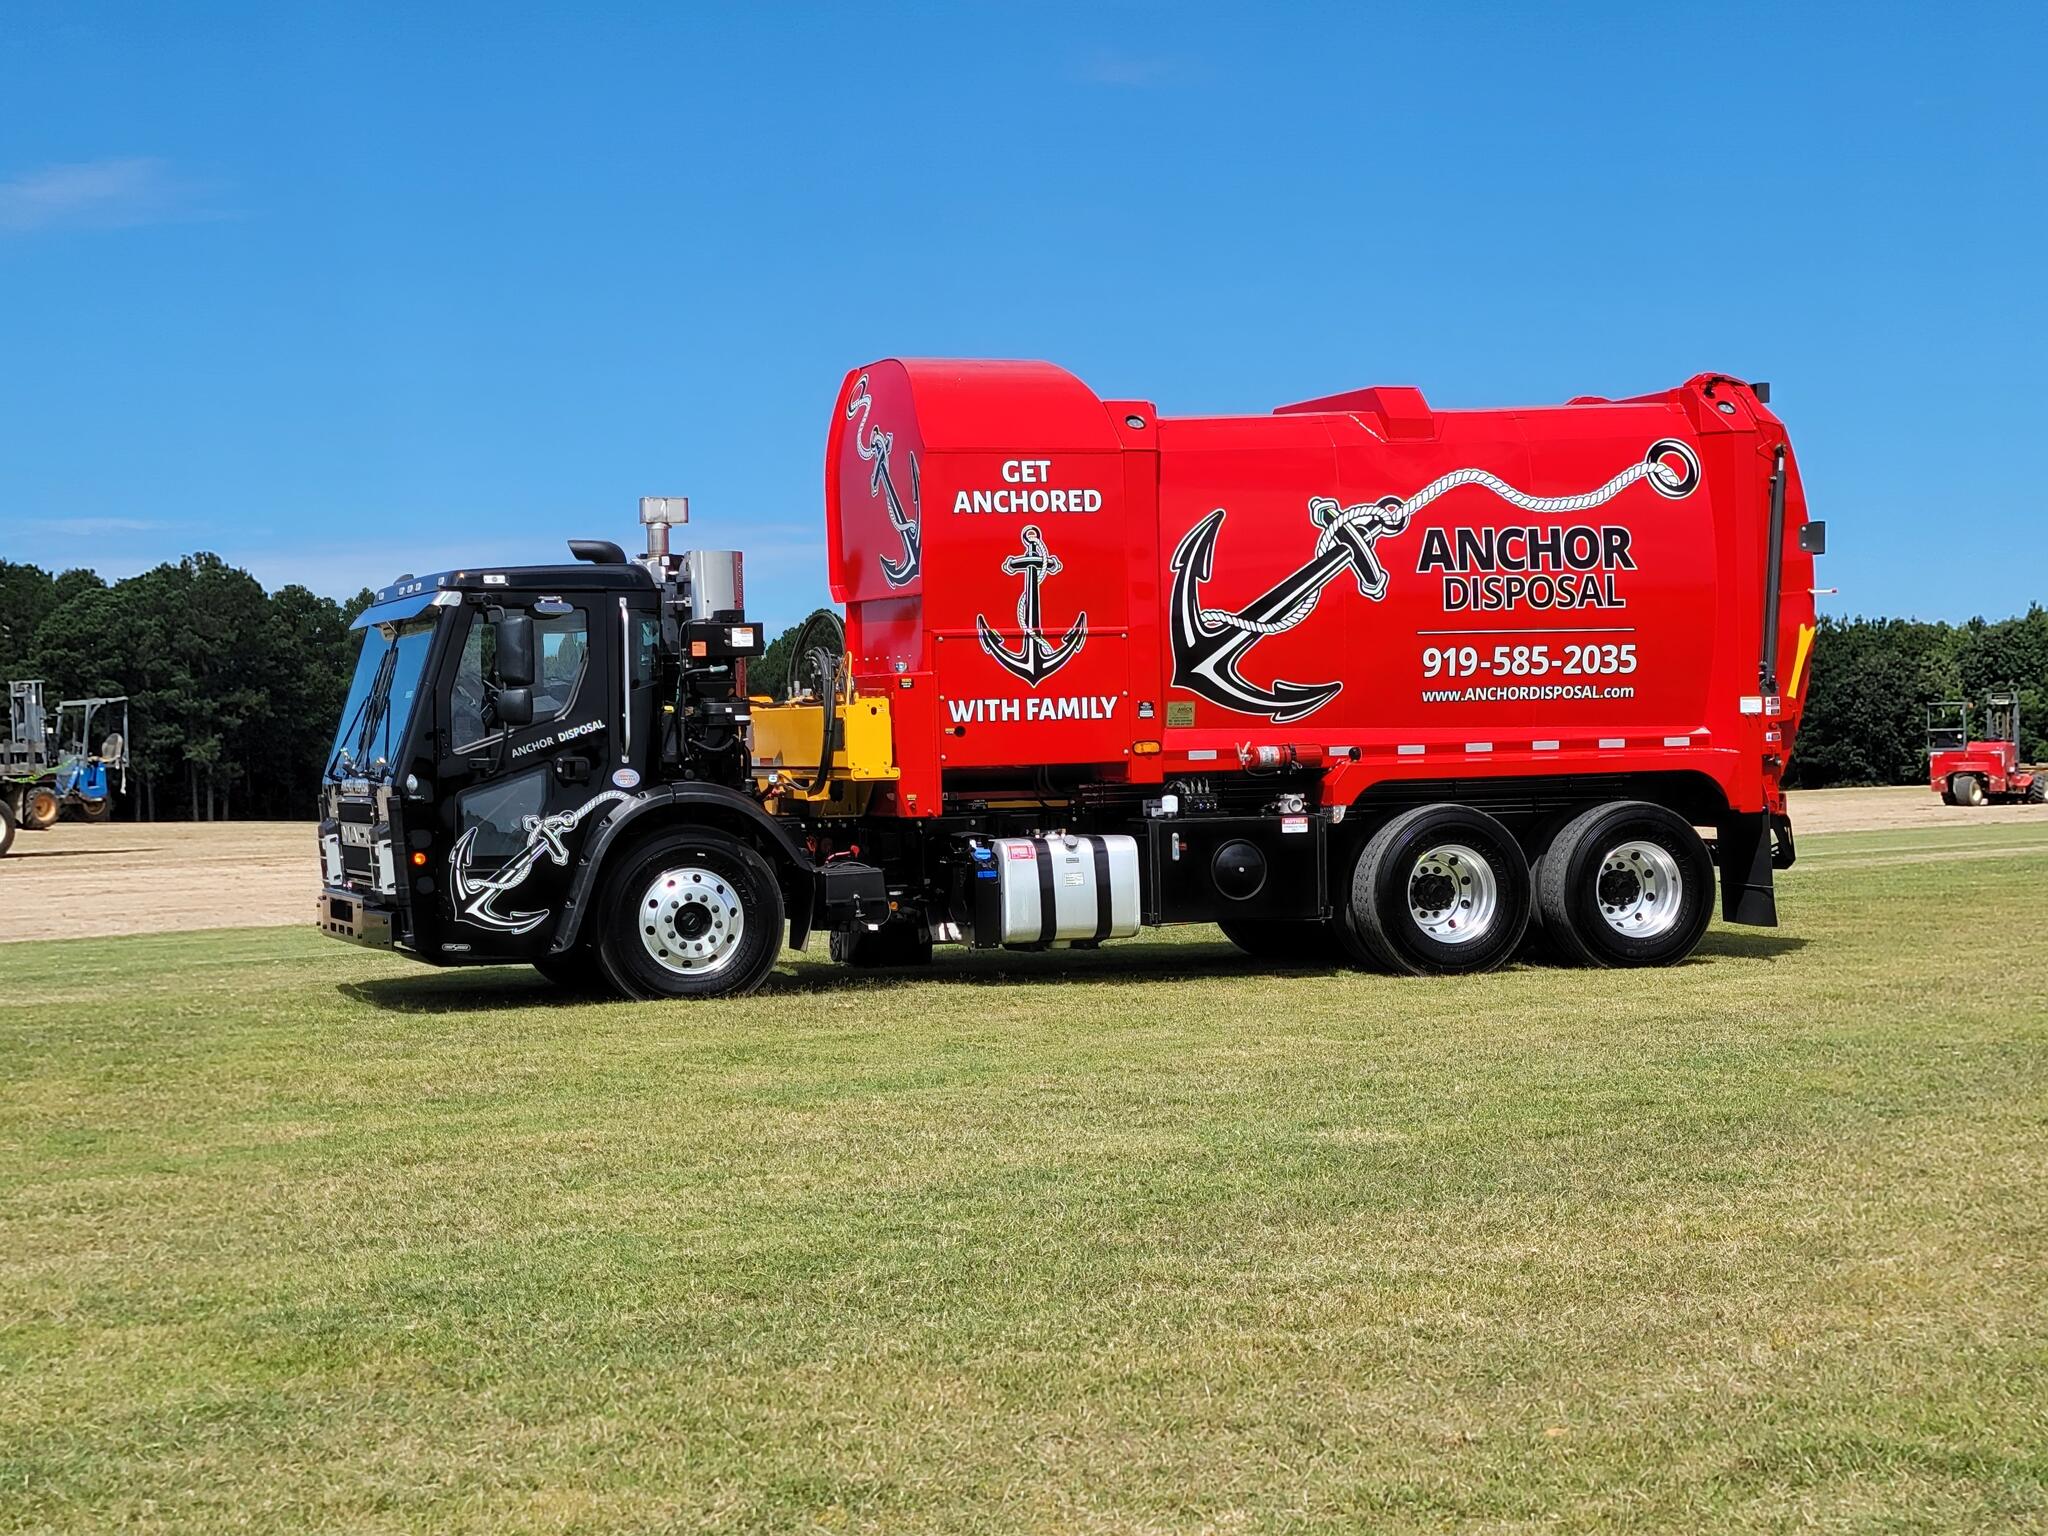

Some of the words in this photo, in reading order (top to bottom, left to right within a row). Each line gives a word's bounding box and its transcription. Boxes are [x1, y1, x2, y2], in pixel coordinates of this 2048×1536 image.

[1001, 460, 1051, 483] GET
[953, 489, 1102, 514] ANCHORED
[1416, 525, 1638, 573] ANCHOR
[1443, 573, 1626, 611] DISPOSAL
[1422, 644, 1638, 678] 919-585-2035
[948, 698, 1020, 723] WITH
[1026, 695, 1118, 721] FAMILY
[1422, 685, 1635, 702] www.ANCHORDISPOSAL.com
[511, 736, 555, 759] ANCHOR
[557, 719, 606, 743] DISPOSAL
